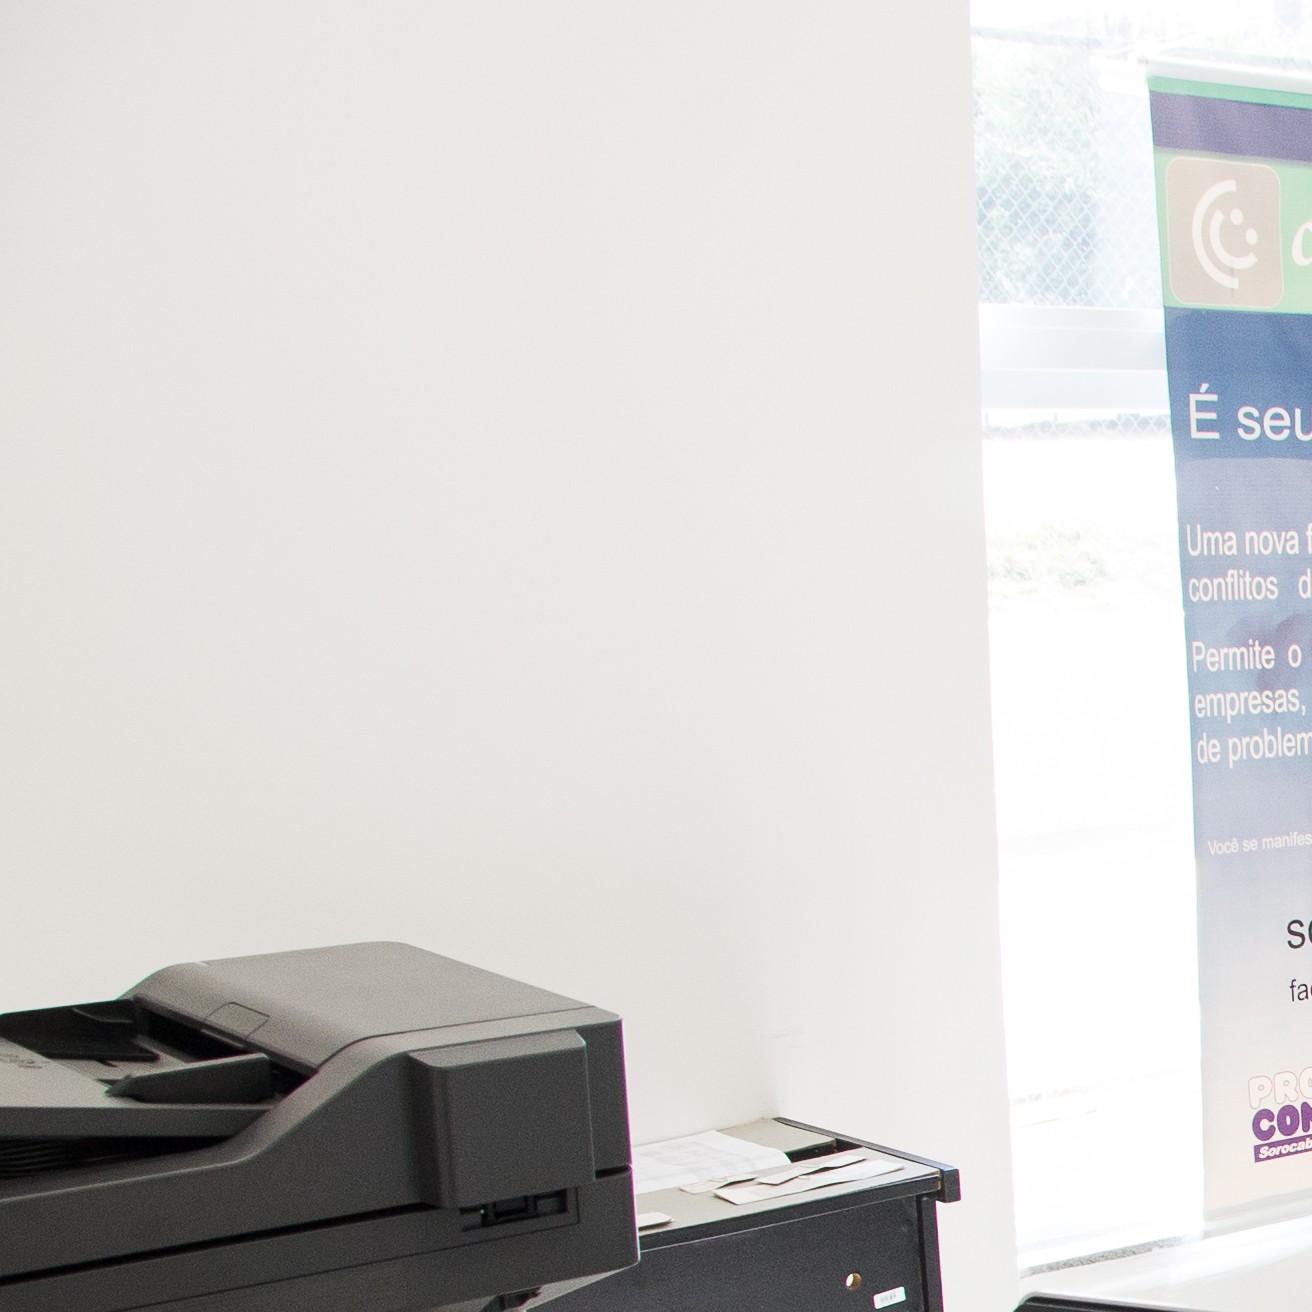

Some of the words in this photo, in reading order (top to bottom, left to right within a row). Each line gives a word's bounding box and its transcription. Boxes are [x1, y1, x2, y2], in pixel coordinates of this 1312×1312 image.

[1188, 383, 1219, 439] É
[1186, 524, 1237, 556] Uma
[1245, 530, 1299, 556] nova
[1188, 569, 1279, 602] conflitos
[1192, 639, 1276, 673] Permite
[1288, 644, 1302, 668] o
[1194, 687, 1306, 724] empresas,
[1196, 732, 1221, 765] de
[1207, 837, 1239, 856] Você
[1242, 838, 1258, 852] se
